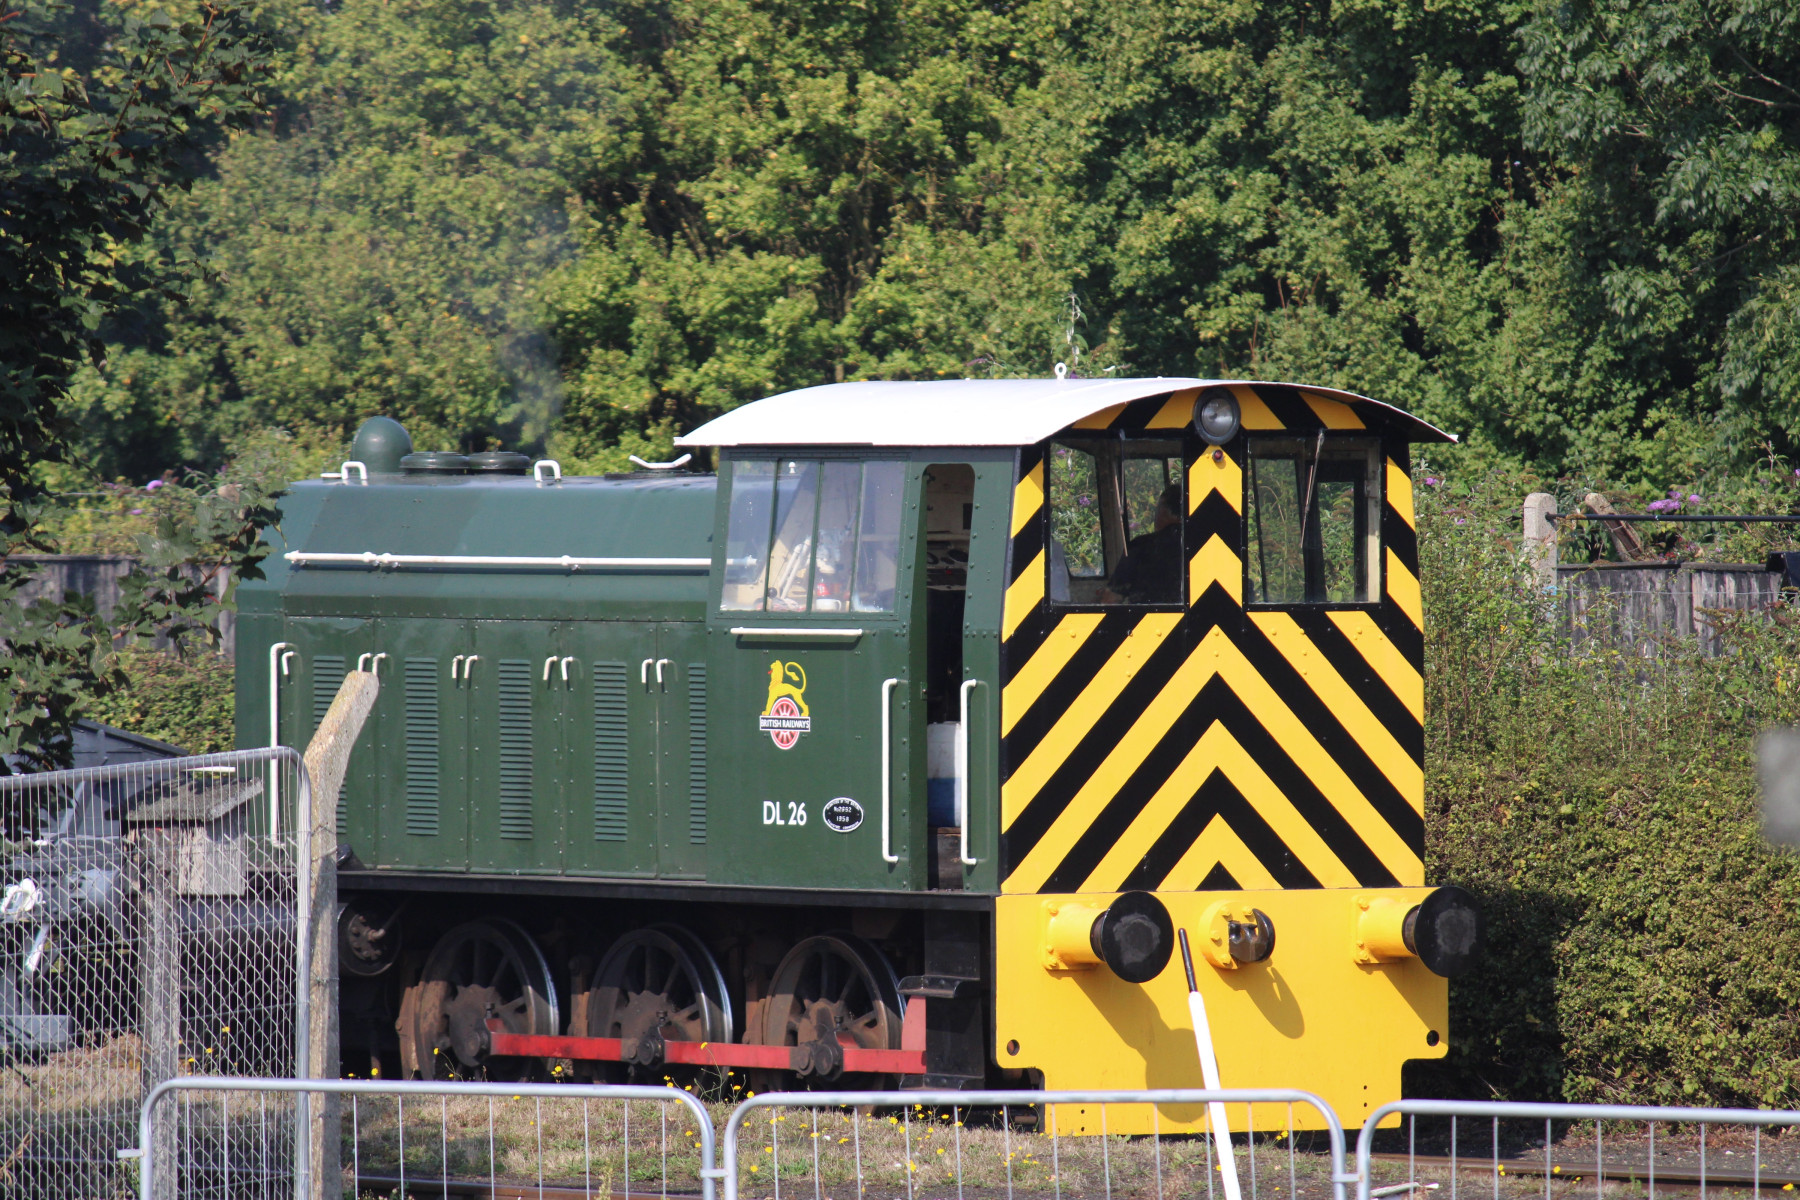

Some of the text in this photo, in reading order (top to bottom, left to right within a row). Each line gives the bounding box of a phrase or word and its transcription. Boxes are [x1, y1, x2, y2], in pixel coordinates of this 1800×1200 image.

[760, 719, 810, 729] BRITISH RAILWAYS
[763, 801, 785, 825] DL
[788, 801, 807, 826] 26
